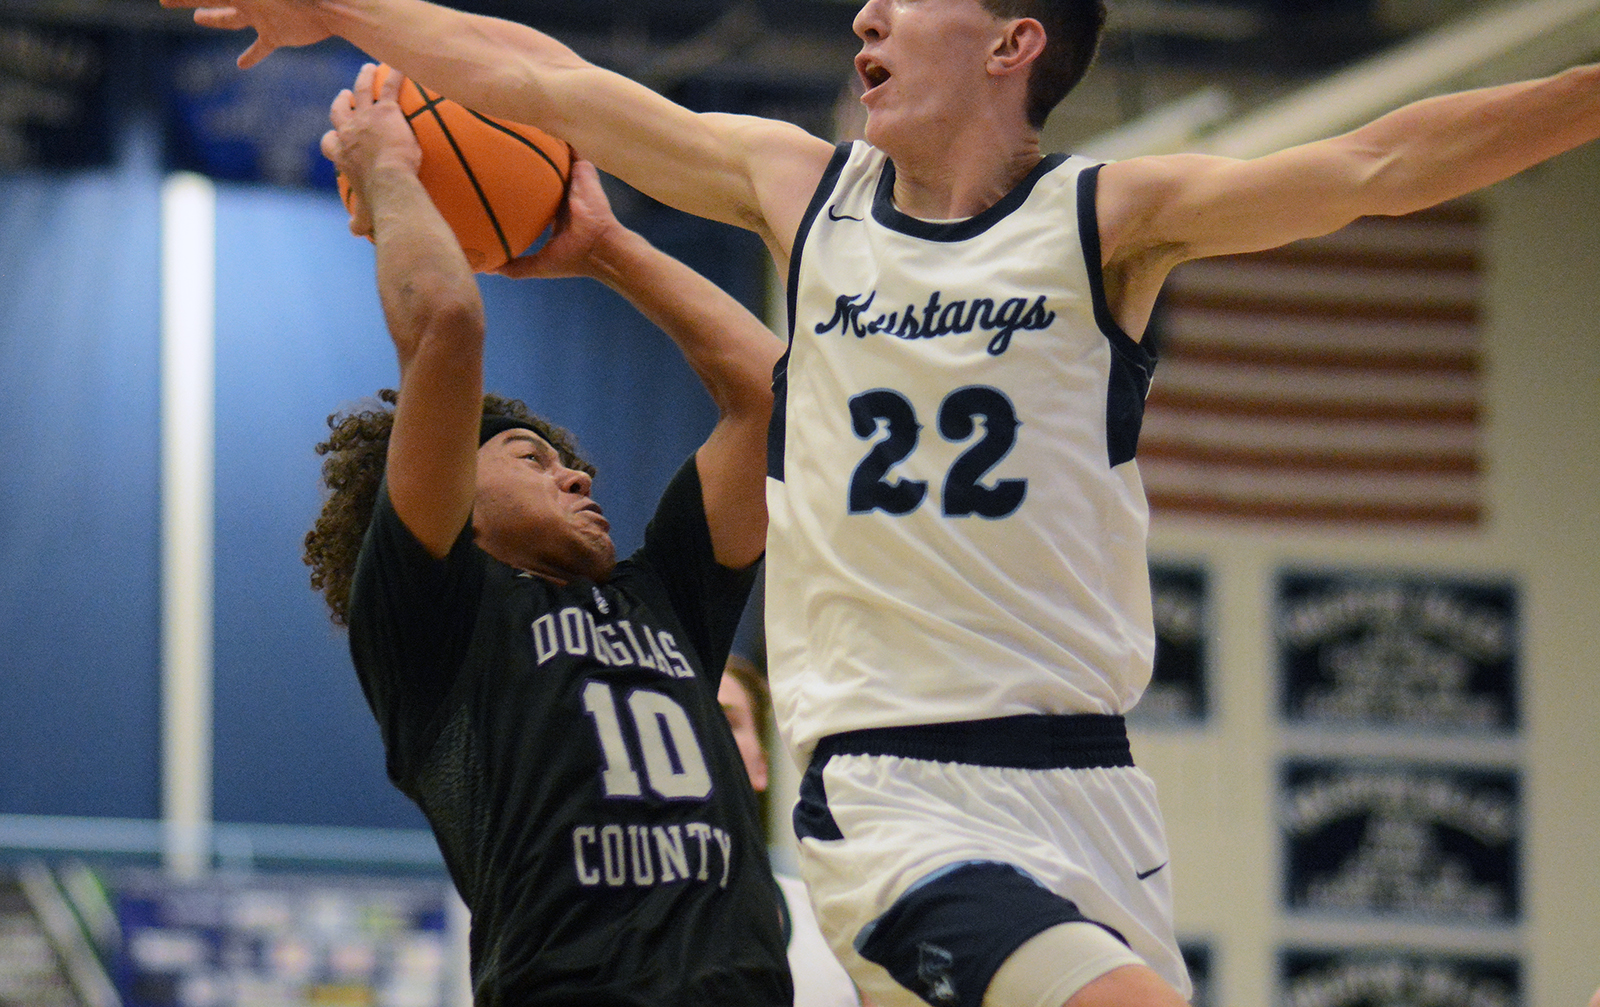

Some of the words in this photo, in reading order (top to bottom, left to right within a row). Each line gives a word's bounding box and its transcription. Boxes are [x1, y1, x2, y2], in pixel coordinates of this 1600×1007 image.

[814, 290, 1056, 356] Mustangs
[847, 384, 1029, 520] 22
[581, 680, 714, 801] 10
[572, 821, 733, 889] COUNTY
